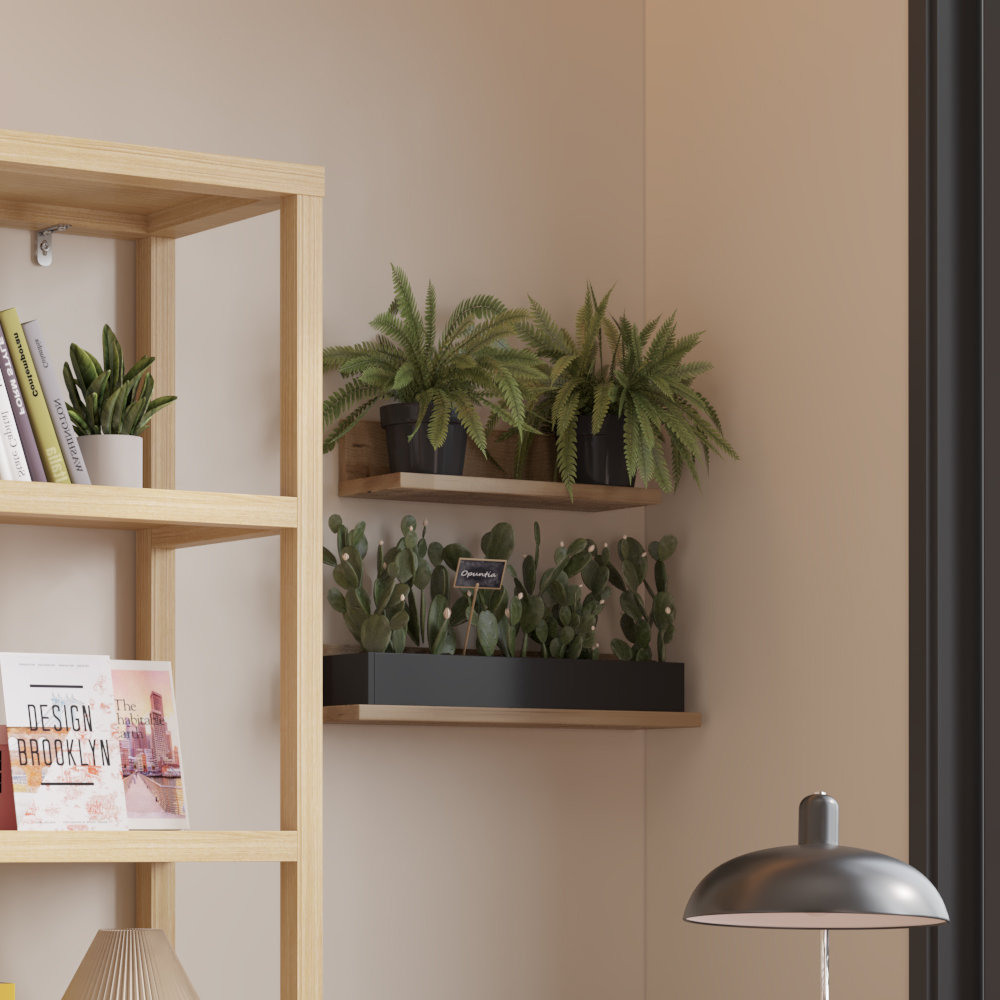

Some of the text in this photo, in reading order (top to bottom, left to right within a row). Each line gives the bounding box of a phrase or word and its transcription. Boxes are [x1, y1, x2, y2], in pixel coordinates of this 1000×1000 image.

[460, 569, 497, 579] Opuntia
[114, 698, 137, 711] The
[27, 704, 93, 732] DESIGN
[17, 738, 111, 766] BROOKLYN
